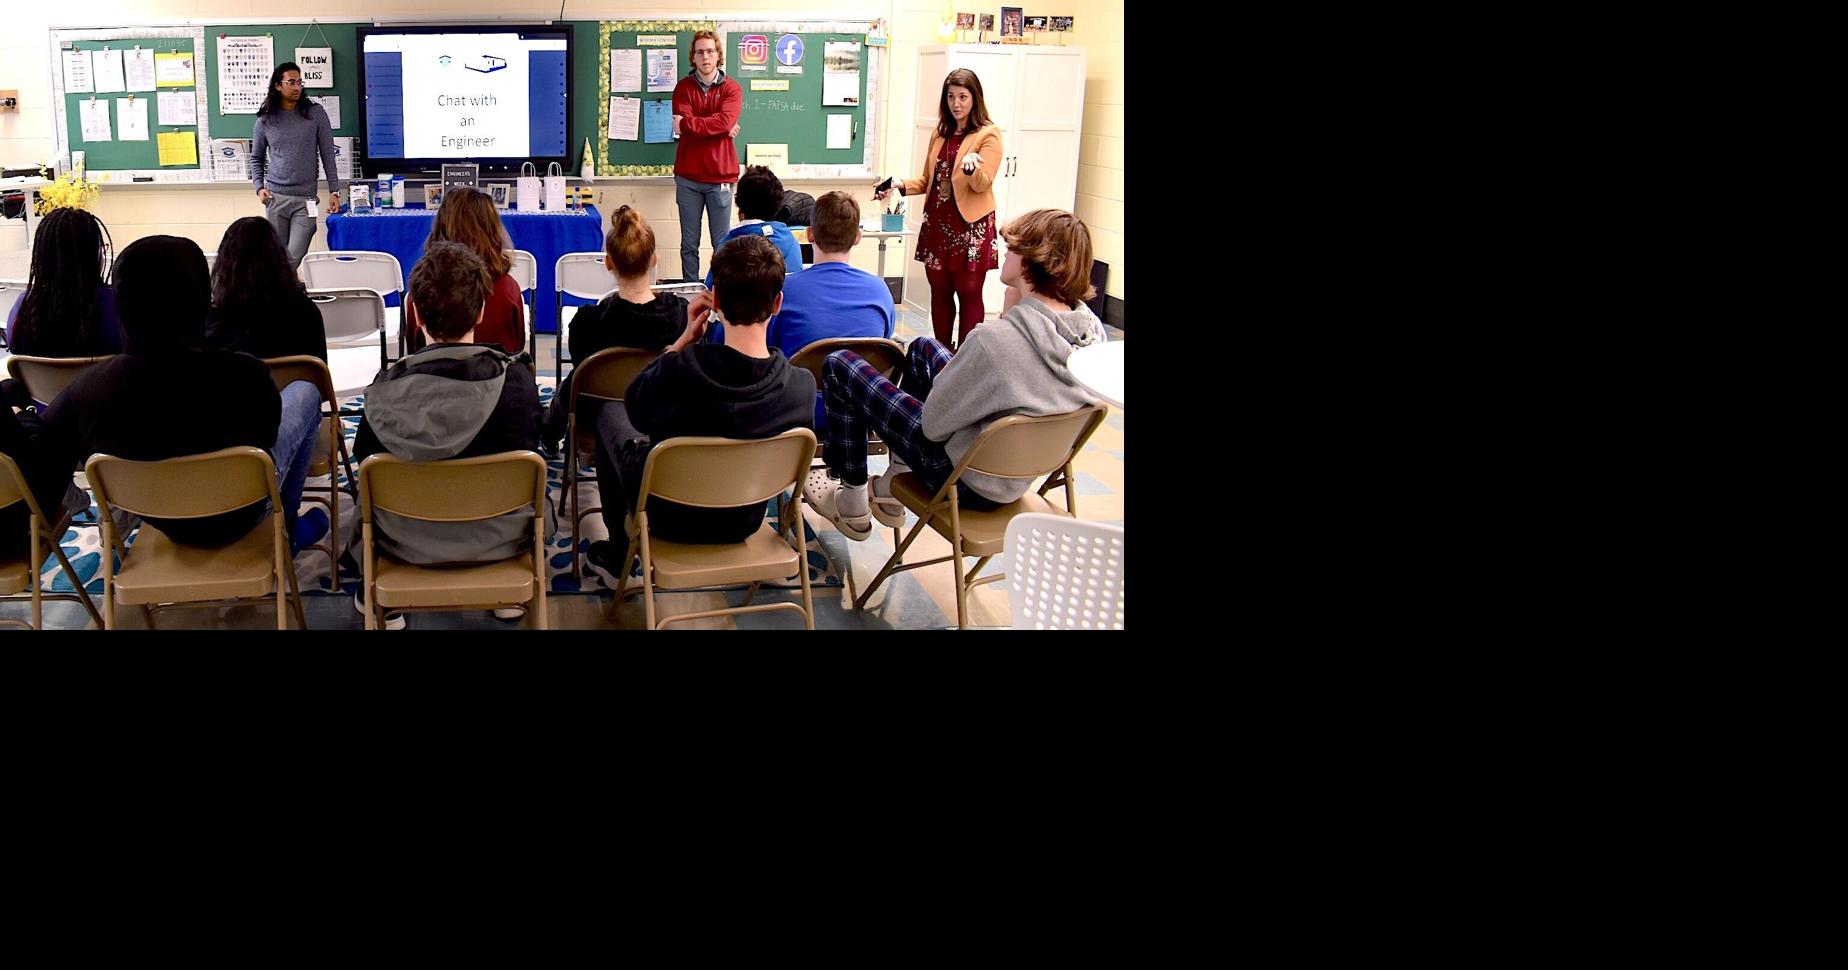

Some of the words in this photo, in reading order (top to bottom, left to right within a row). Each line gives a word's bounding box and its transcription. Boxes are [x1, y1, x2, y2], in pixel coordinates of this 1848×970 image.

[301, 56, 327, 64] FOLLOW
[304, 71, 323, 80] BLISS
[438, 94, 466, 107] Chat
[470, 93, 497, 106] with
[460, 117, 475, 127] an
[441, 135, 496, 150] Engineer
